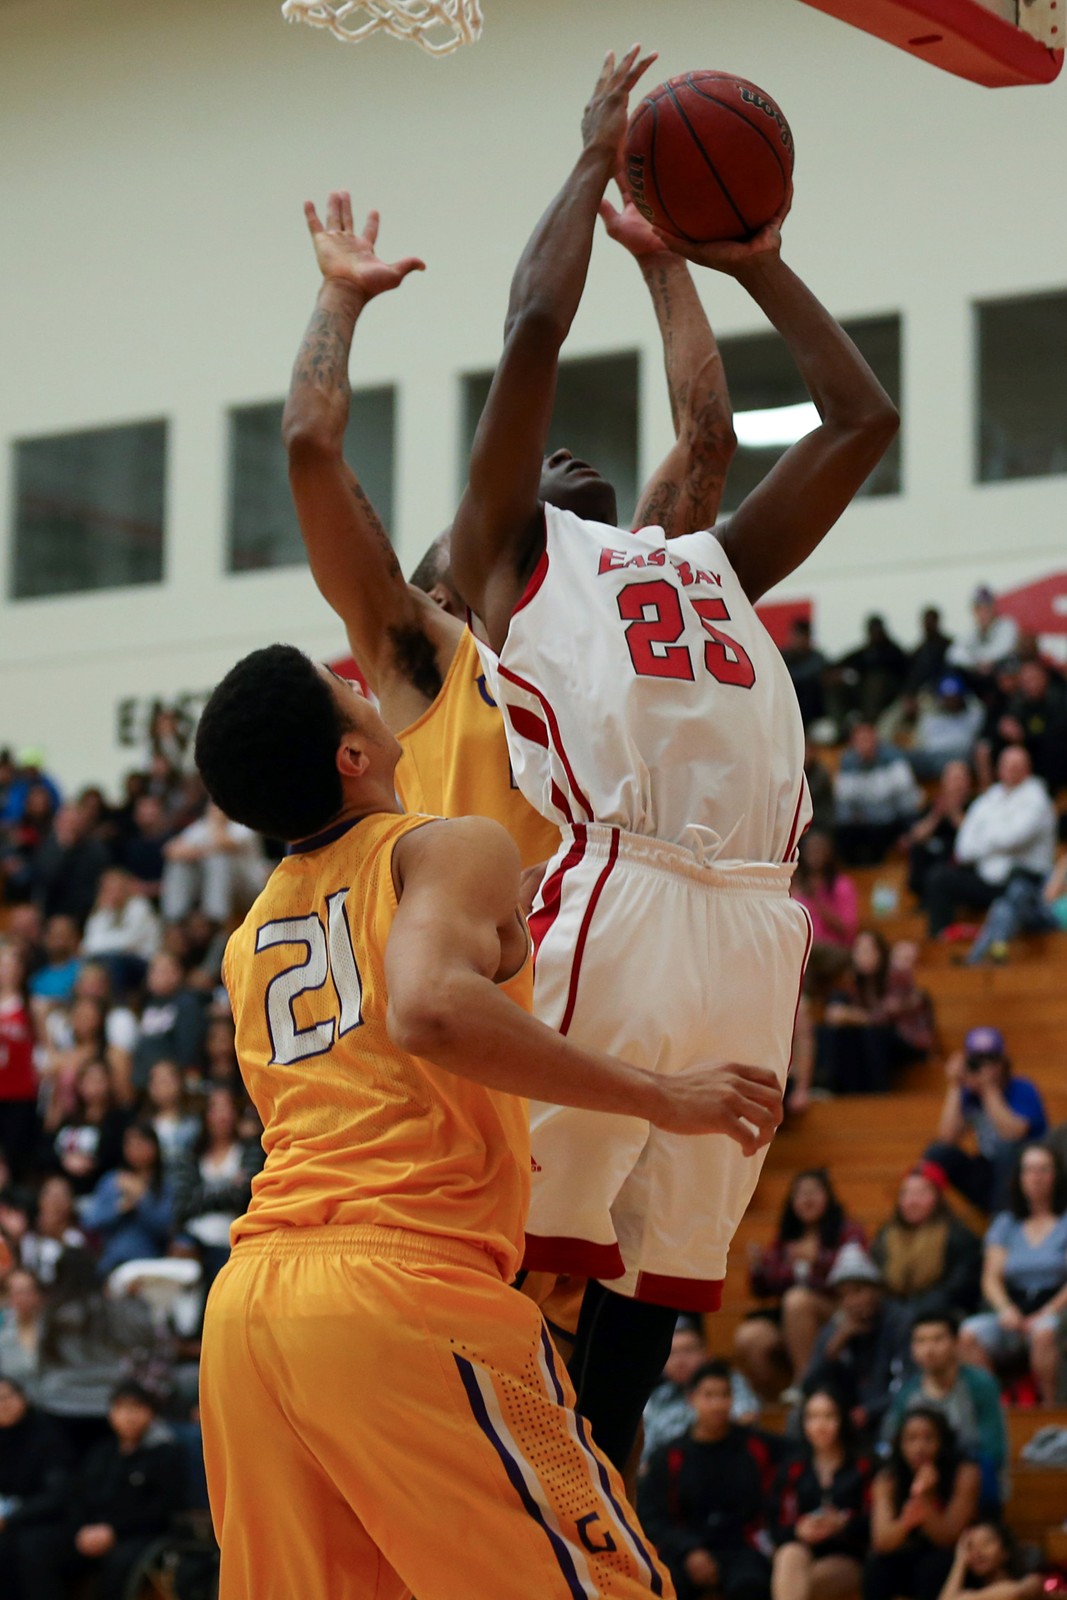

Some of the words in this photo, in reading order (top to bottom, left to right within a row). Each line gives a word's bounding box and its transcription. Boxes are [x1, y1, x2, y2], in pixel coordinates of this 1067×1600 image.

[597, 547, 668, 576] EAS
[616, 579, 756, 689] 25
[254, 887, 364, 1066] 21
